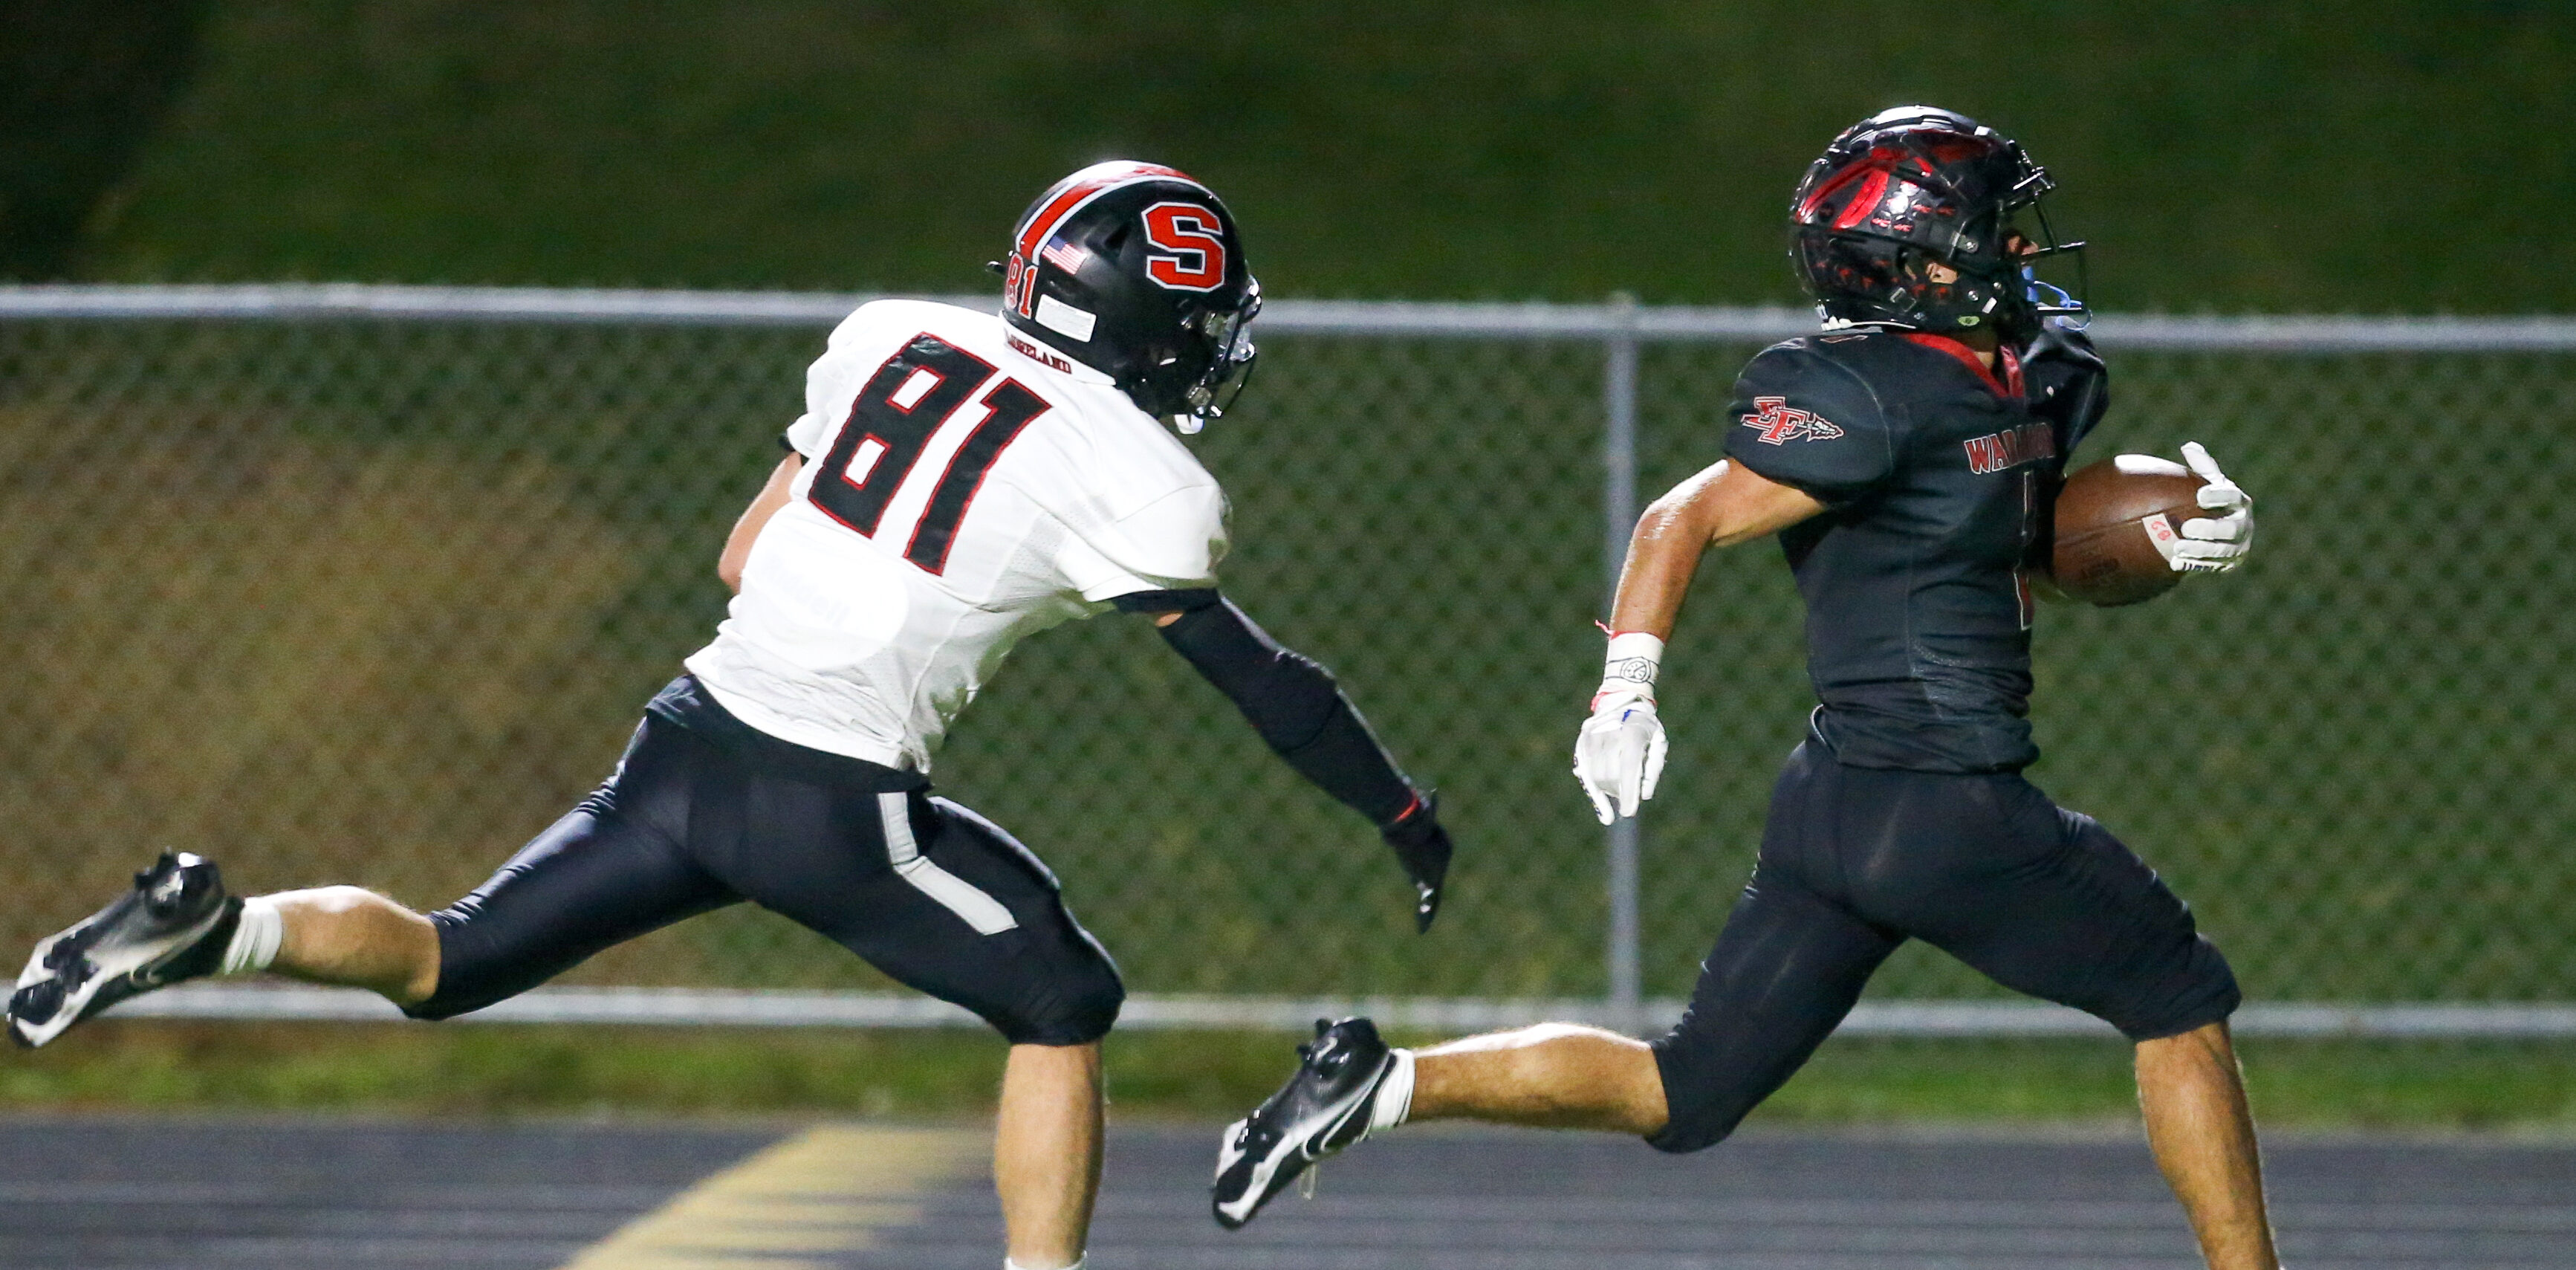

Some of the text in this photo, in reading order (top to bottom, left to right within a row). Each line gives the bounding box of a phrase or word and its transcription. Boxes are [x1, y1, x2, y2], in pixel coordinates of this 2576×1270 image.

[1005, 253, 1038, 319] 81
[1142, 201, 1225, 292] S
[808, 331, 1052, 577] 81
